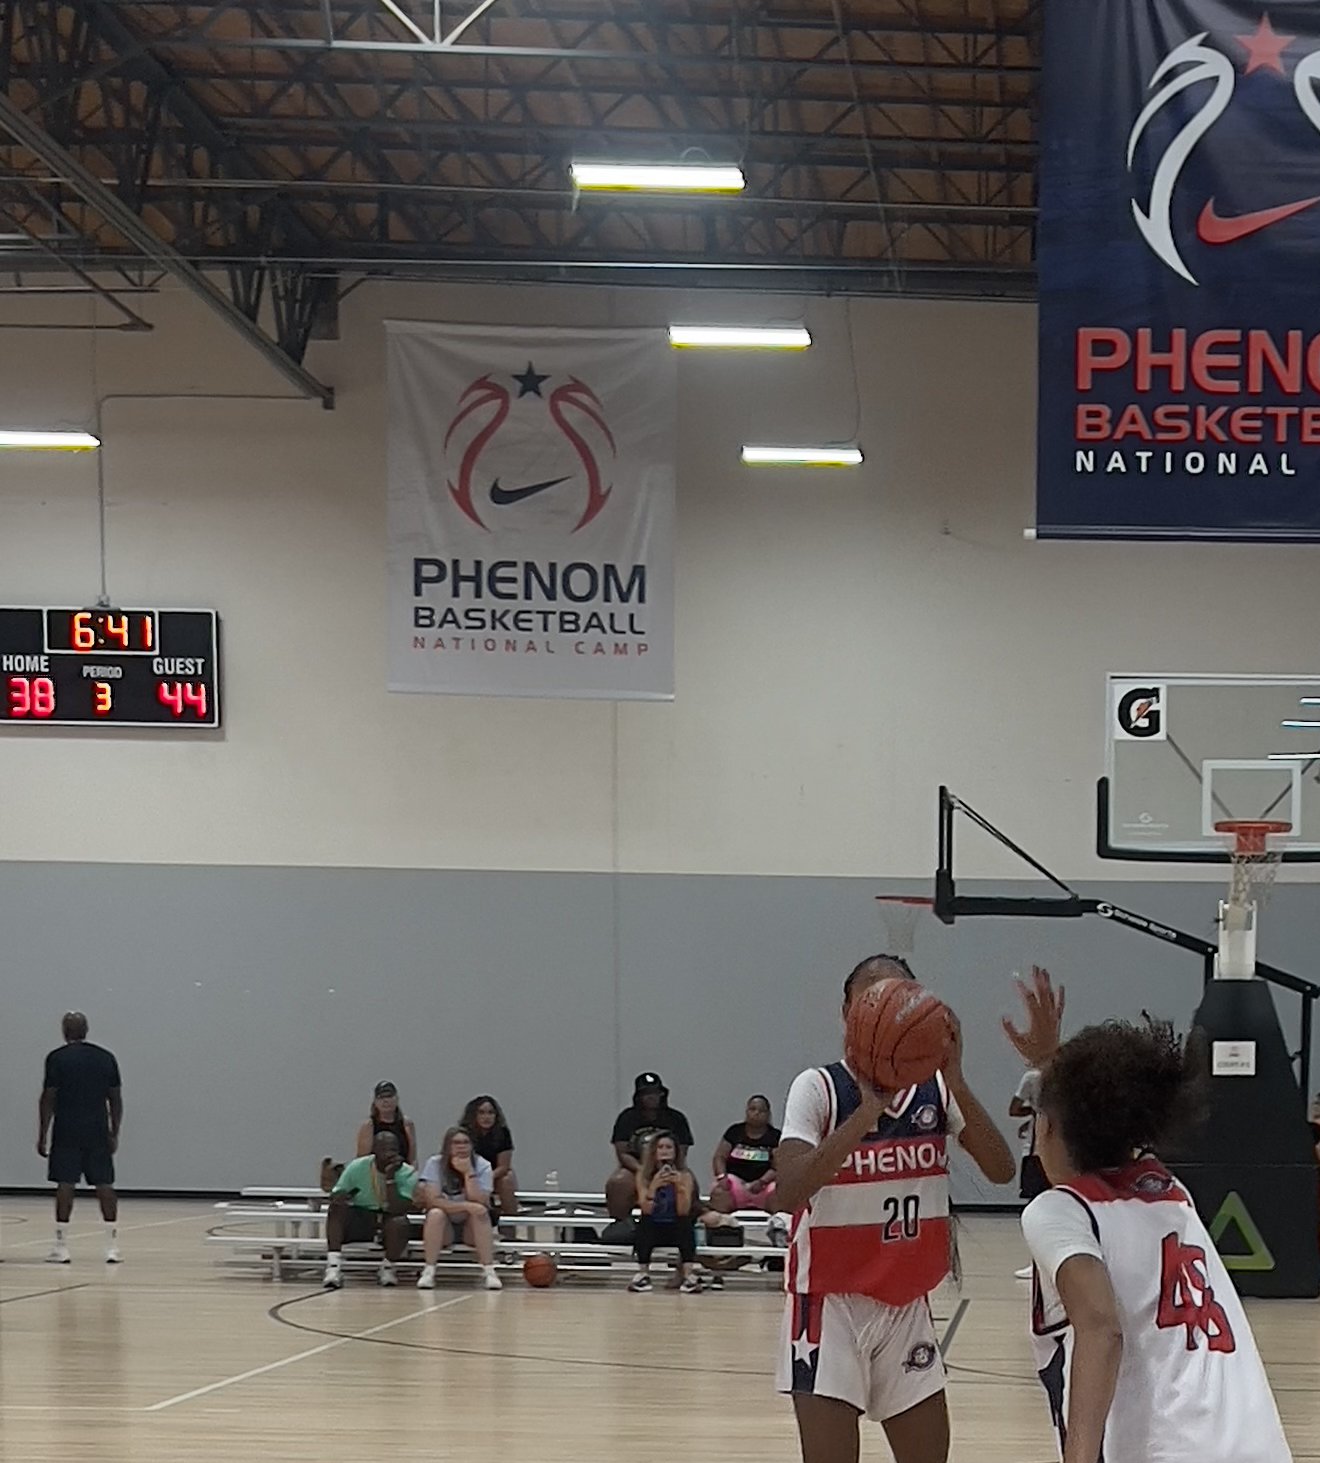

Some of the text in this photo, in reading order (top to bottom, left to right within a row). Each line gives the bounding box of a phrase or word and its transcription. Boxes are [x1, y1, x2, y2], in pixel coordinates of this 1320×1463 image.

[1075, 450, 1296, 475] NATIONAL
[413, 557, 646, 603] PHENOM
[72, 611, 152, 650] 6:41
[413, 606, 646, 635] BASKETBALL
[412, 636, 649, 656] NATIONAL CAMP
[2, 655, 50, 673] HOME
[82, 665, 123, 678] PERIOD
[152, 657, 205, 675] GUEST
[8, 677, 55, 716] 38
[94, 681, 112, 713] 3
[158, 681, 206, 716] 44
[1118, 687, 1160, 737] G
[881, 1194, 920, 1243] 20
